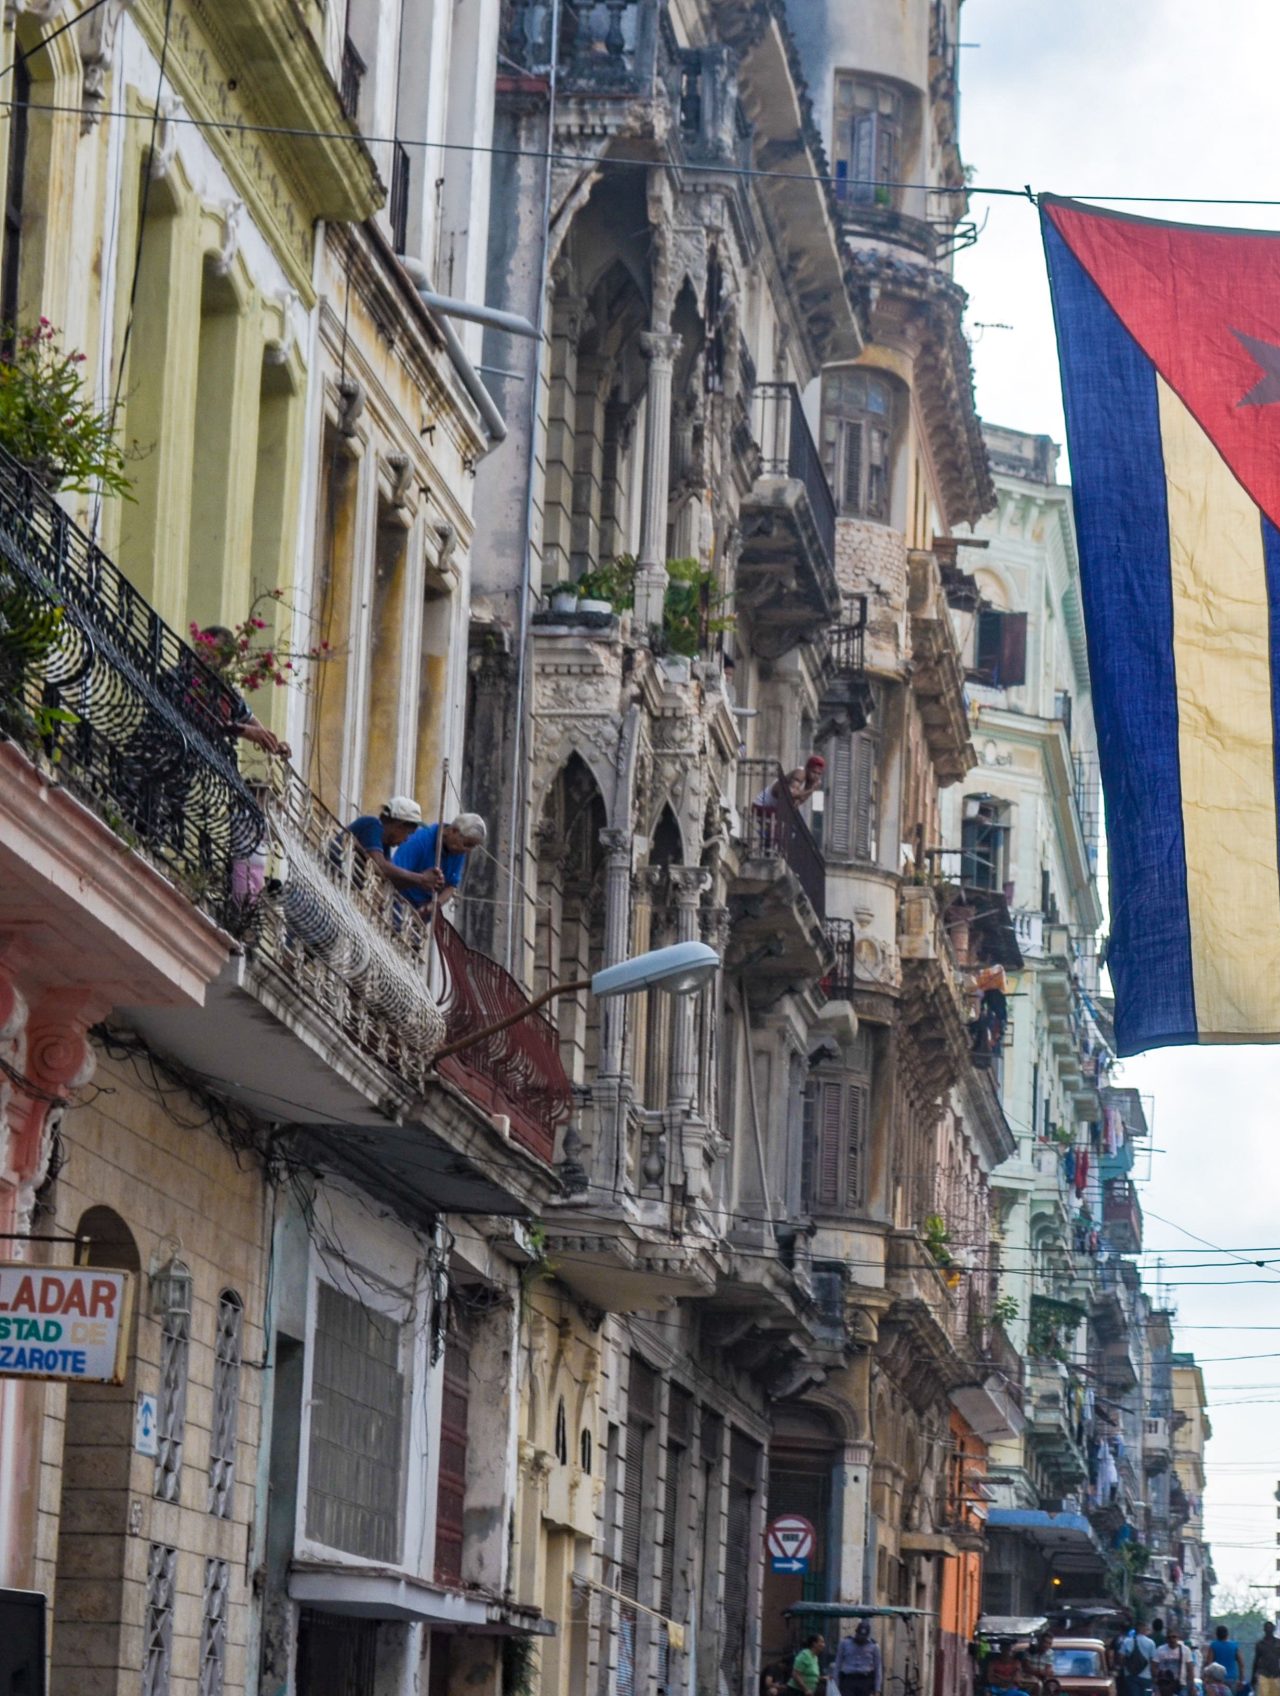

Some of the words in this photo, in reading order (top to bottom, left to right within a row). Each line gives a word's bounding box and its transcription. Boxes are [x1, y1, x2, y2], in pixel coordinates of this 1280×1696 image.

[0, 1317, 63, 1343] STAD
[71, 1321, 108, 1345] DE
[0, 1345, 86, 1374] ZAROTE
